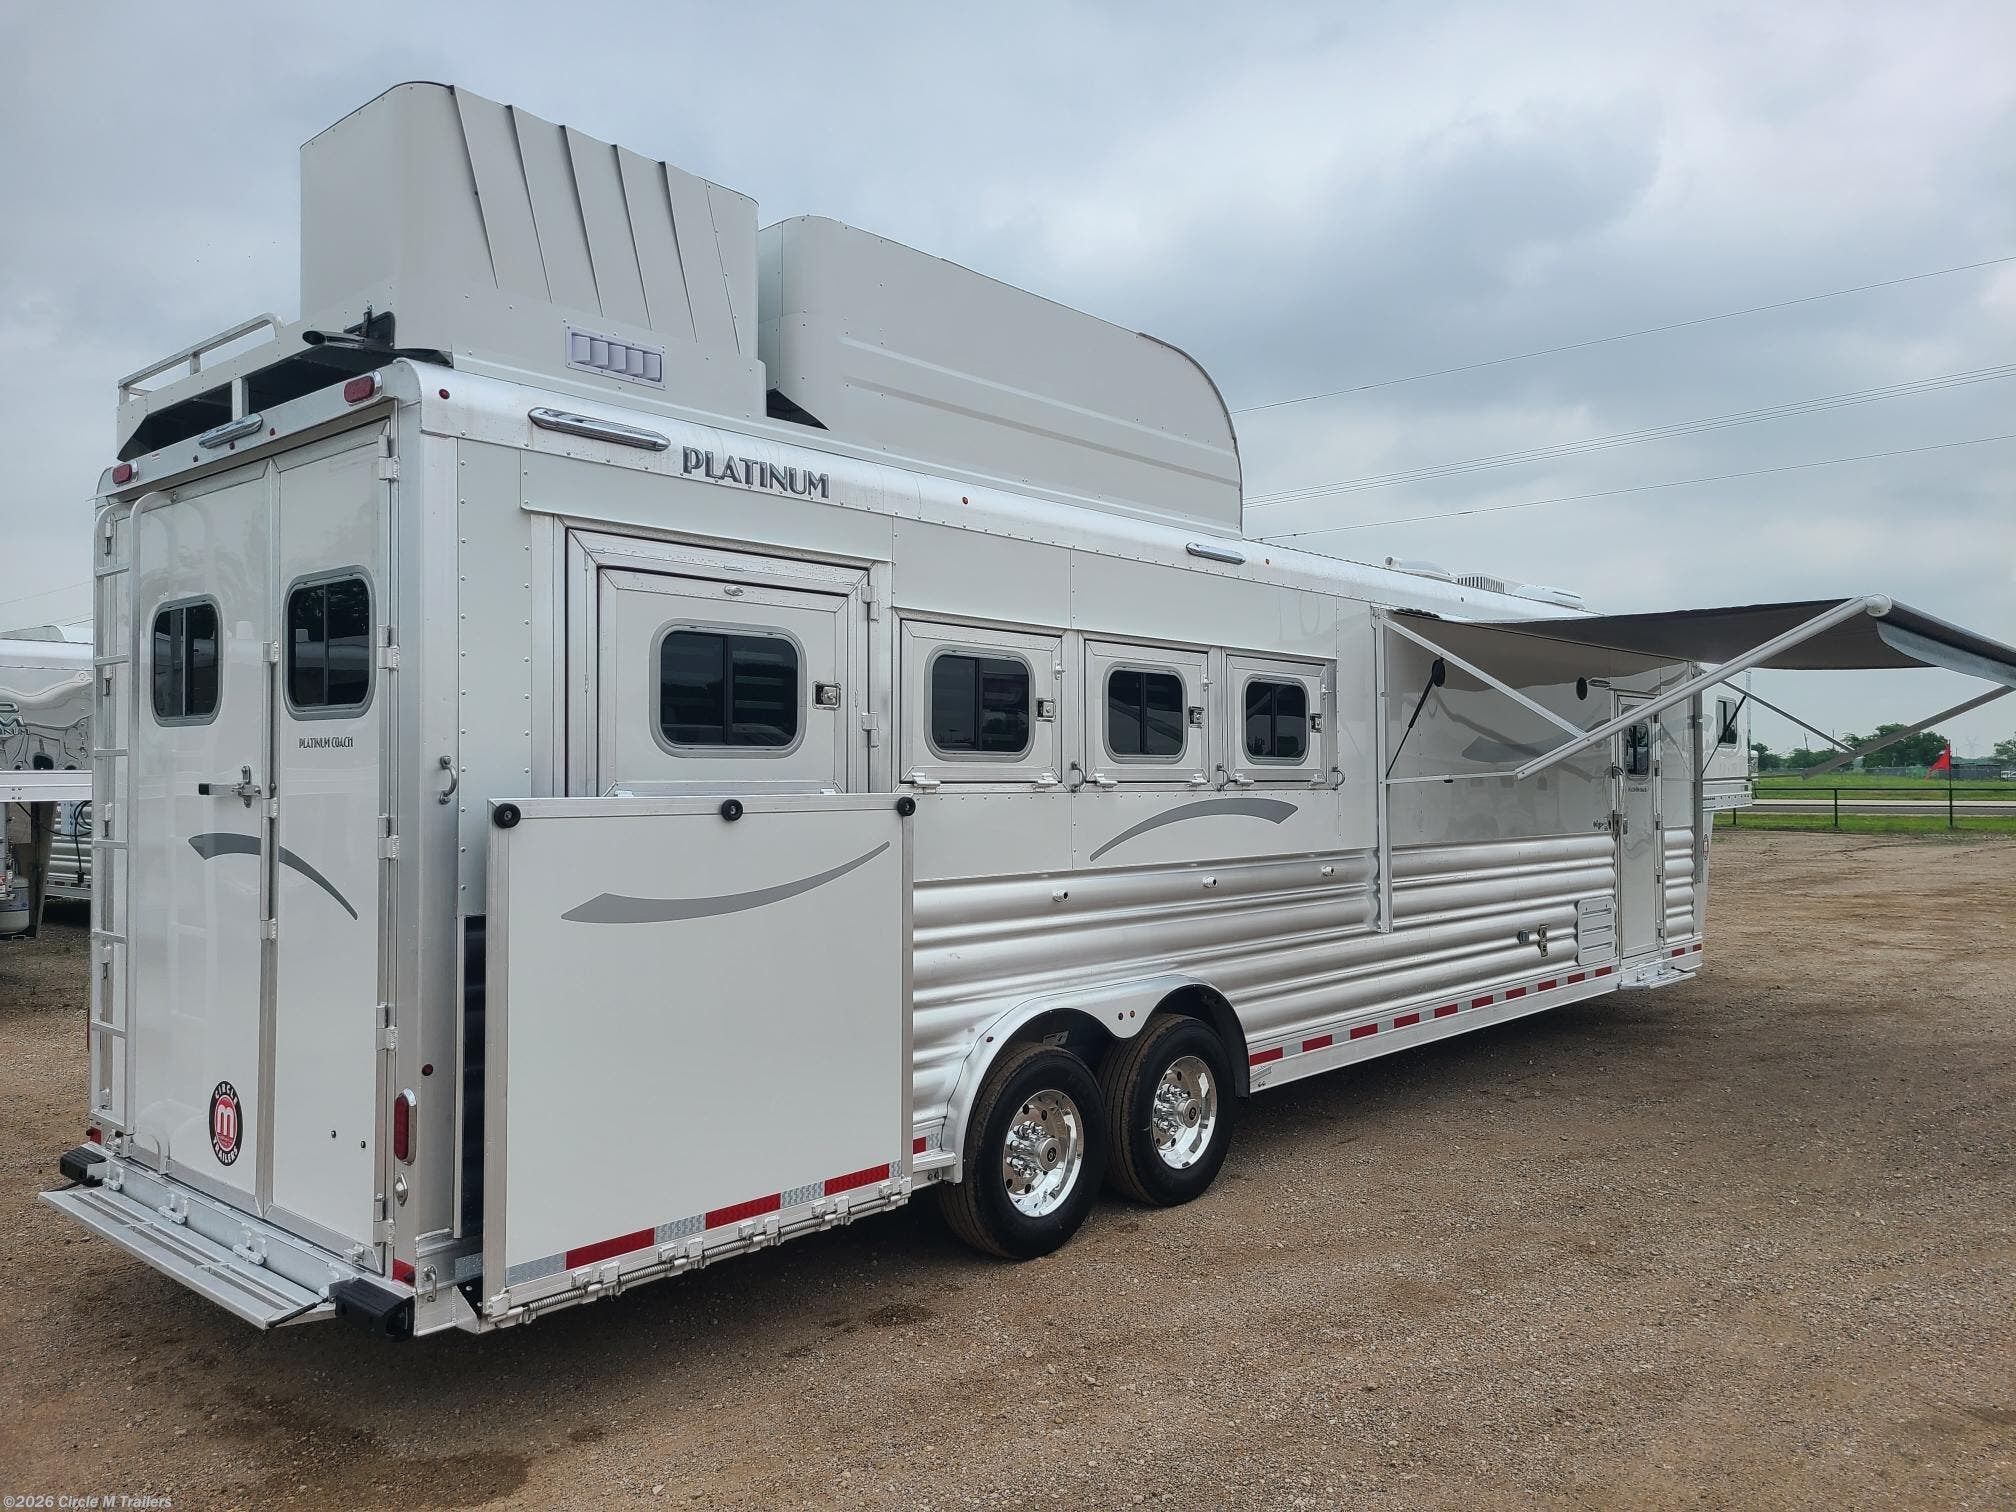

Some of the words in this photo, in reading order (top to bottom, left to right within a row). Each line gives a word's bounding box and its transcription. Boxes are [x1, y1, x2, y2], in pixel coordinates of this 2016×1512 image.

[682, 446, 830, 498] PLATINUM
[299, 737, 330, 748] PLATINUM
[331, 736, 353, 748] COACH
[215, 1083, 239, 1105] CIRCLE
[213, 1136, 238, 1163] TRAILERS
